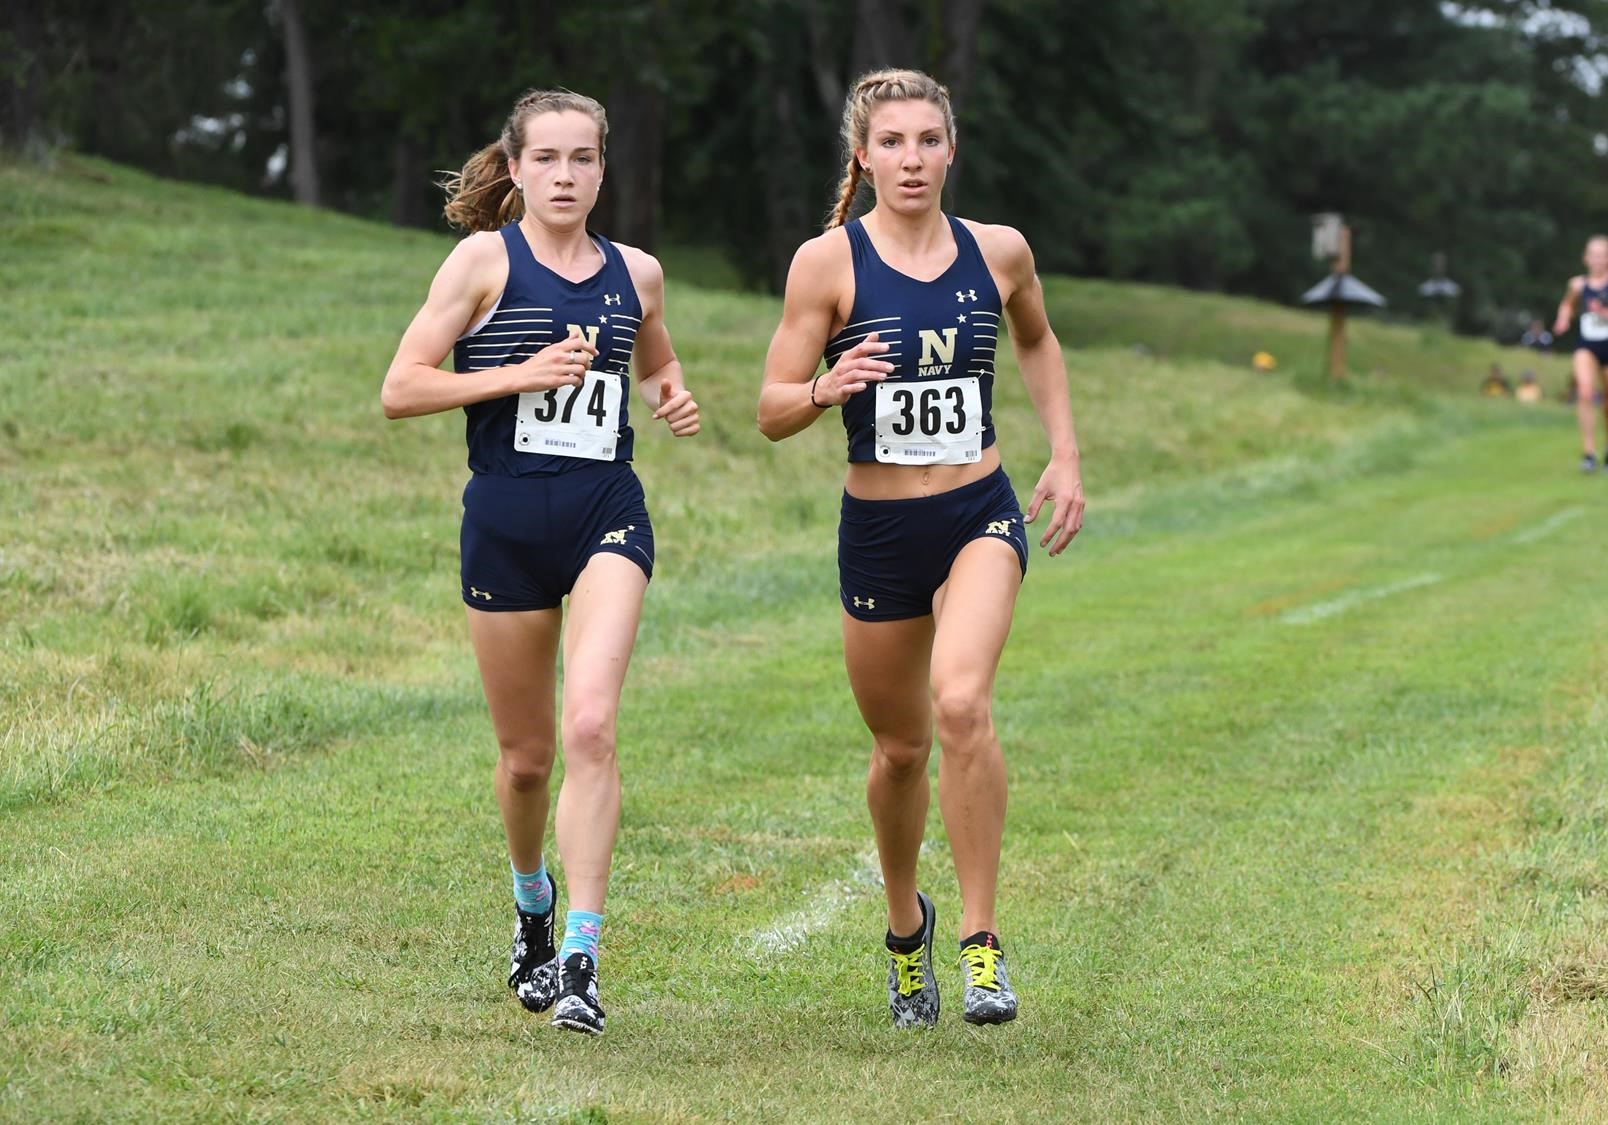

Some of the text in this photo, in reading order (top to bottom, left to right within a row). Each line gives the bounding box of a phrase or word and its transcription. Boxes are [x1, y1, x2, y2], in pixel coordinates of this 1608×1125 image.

[918, 327, 958, 366] N
[917, 364, 953, 377] NAVY
[534, 379, 607, 427] 374
[892, 386, 967, 436] 363
